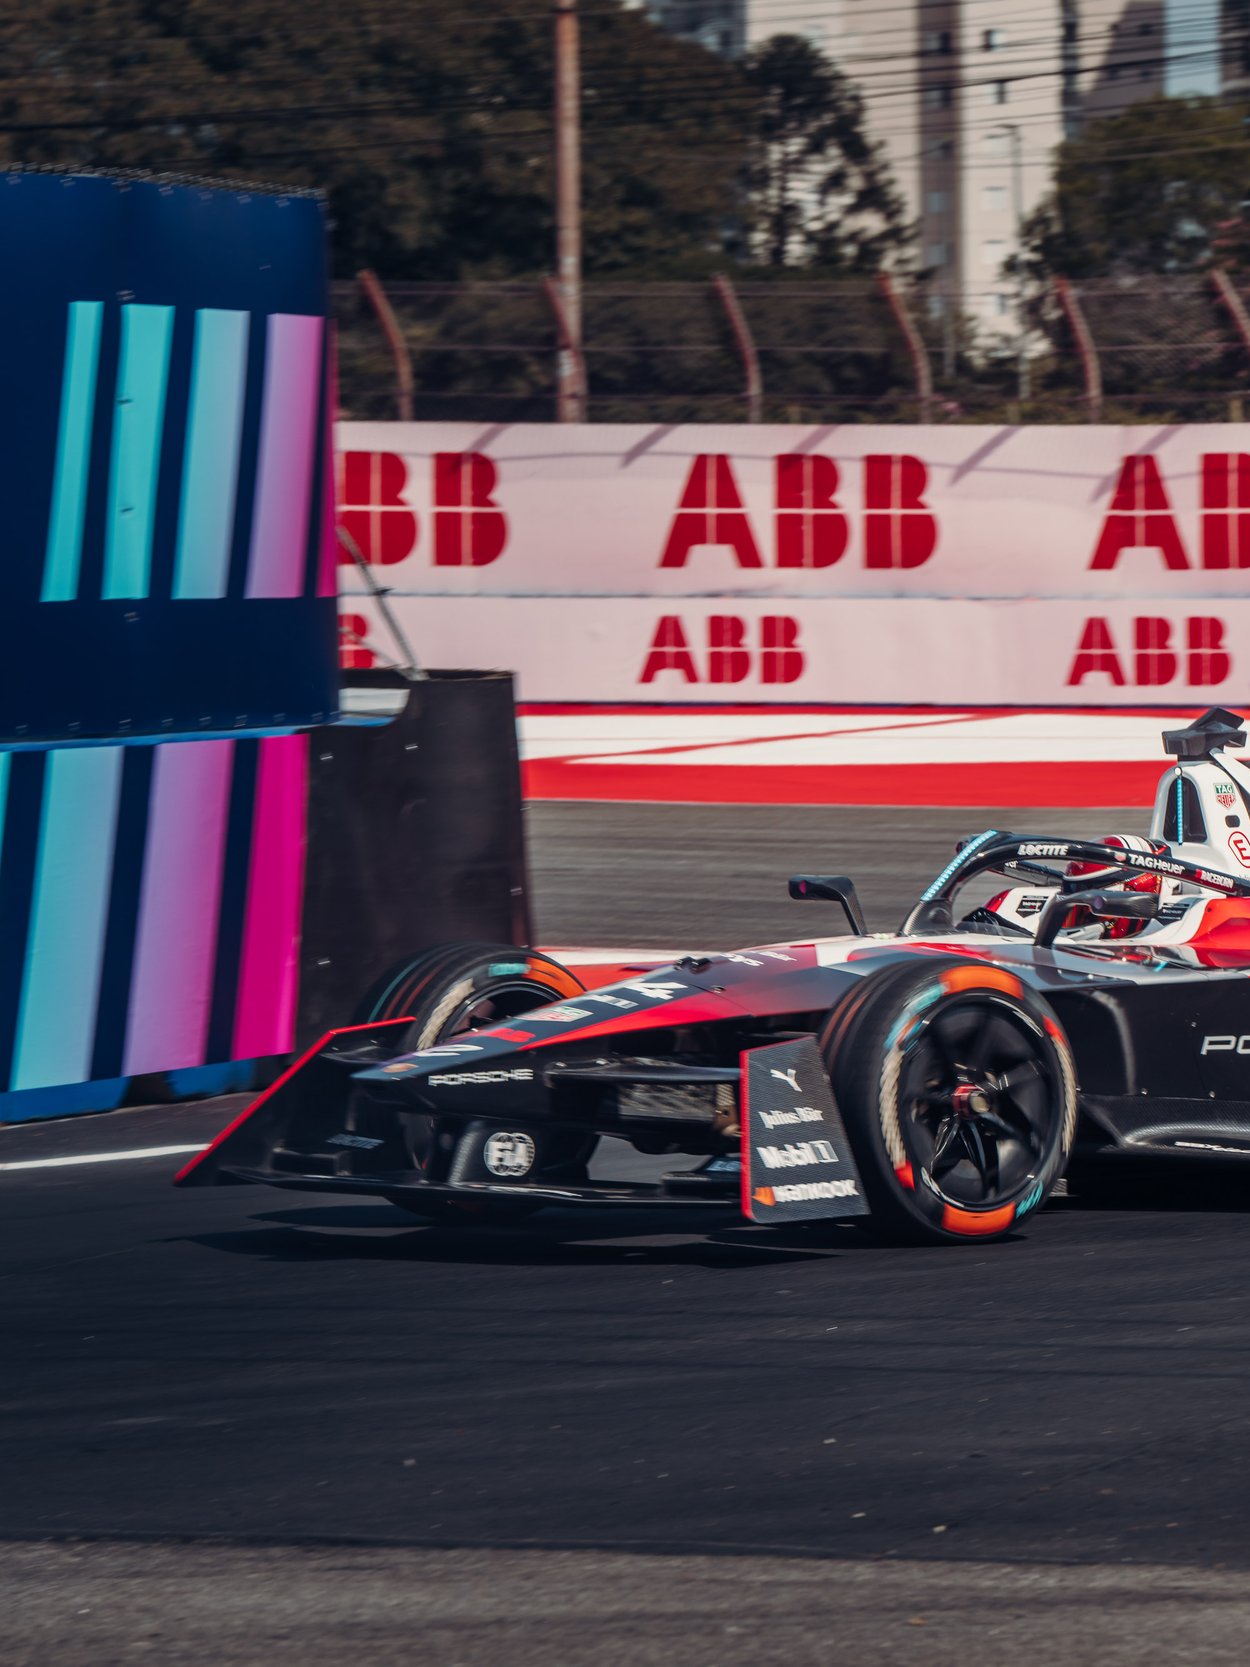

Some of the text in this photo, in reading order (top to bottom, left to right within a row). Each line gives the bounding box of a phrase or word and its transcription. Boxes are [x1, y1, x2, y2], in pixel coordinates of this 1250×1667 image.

[337, 451, 509, 567] BB
[658, 452, 938, 569] ABB
[638, 614, 807, 685] ABB
[1066, 615, 1233, 687] ABB
[1018, 844, 1069, 856] LOCTITE
[428, 1068, 534, 1087] PORSCHE
